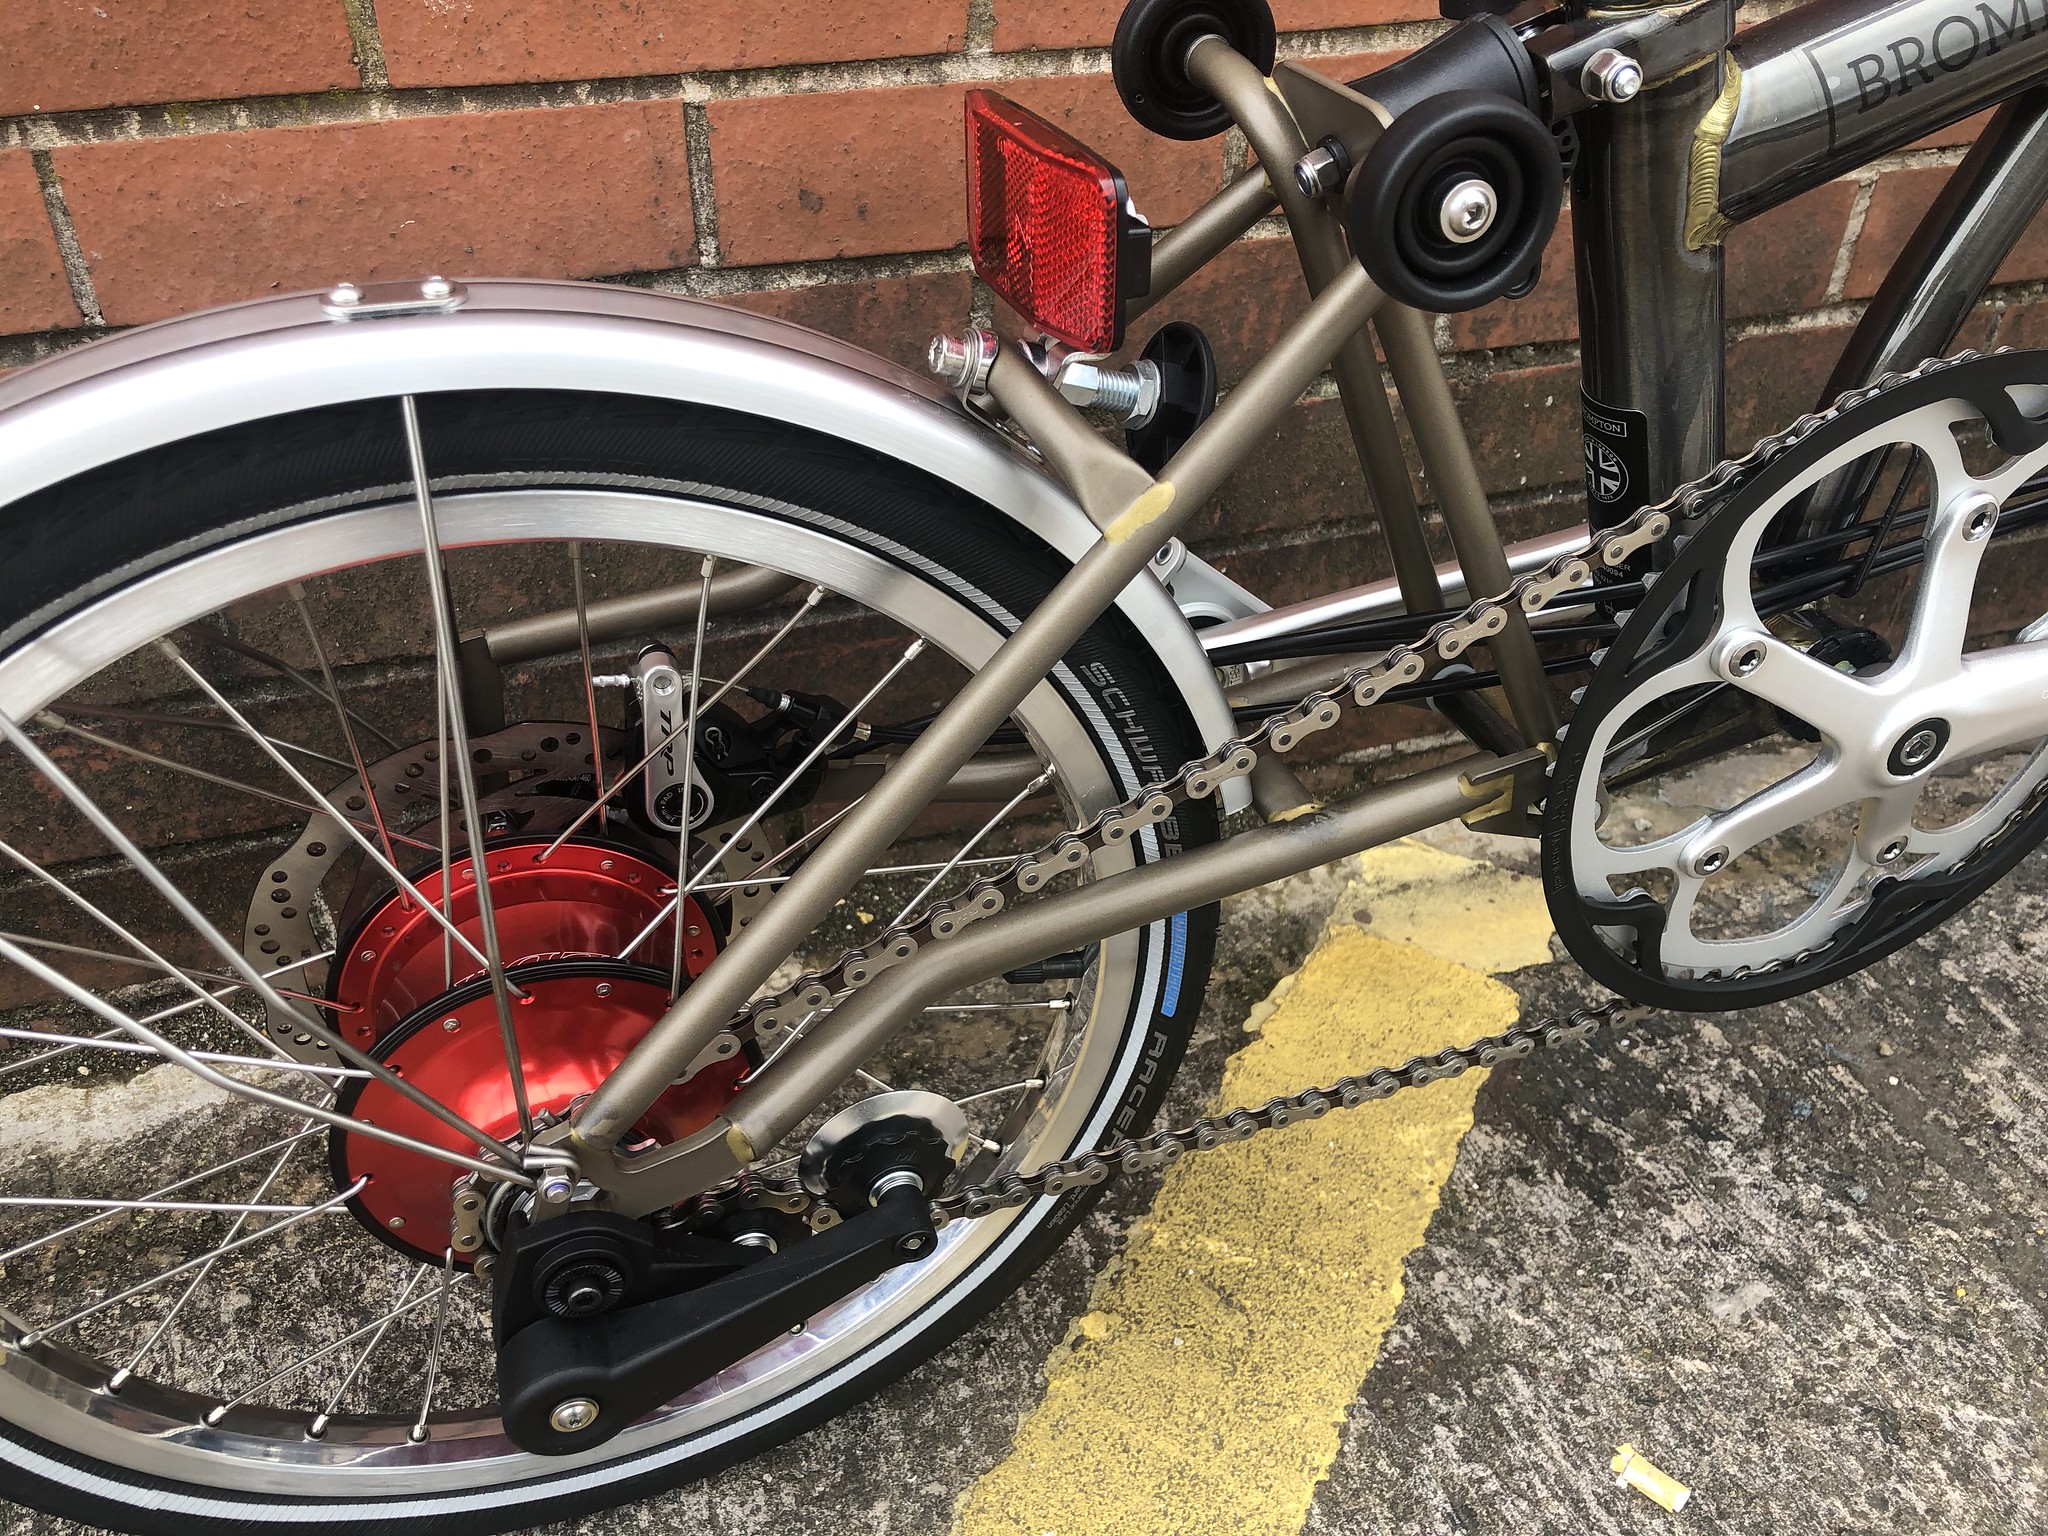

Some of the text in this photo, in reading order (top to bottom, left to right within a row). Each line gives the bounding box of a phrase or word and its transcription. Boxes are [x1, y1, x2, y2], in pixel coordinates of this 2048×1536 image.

[659, 709, 675, 777] TRP
[1080, 661, 1183, 859] SCHWABE
[660, 790, 674, 805] PAD
